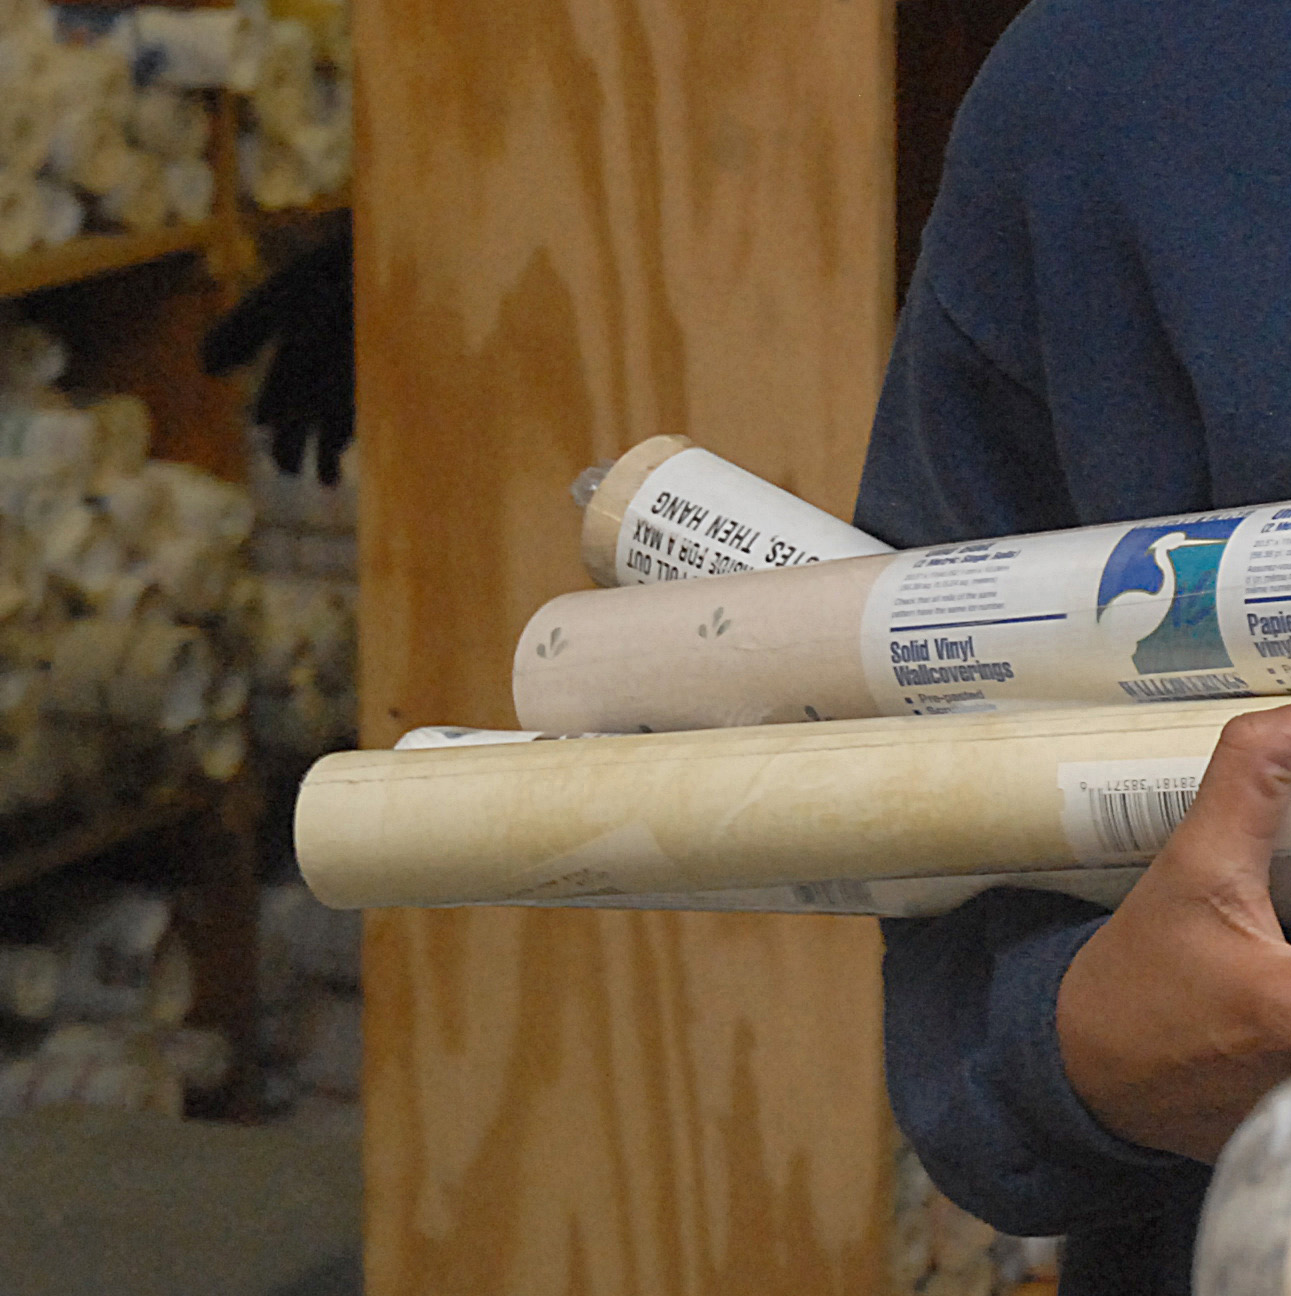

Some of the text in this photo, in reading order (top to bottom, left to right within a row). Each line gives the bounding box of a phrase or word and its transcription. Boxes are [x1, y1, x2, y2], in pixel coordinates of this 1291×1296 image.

[652, 492, 709, 531] HANG
[633, 519, 663, 551] MAX
[667, 534, 675, 555] A
[705, 515, 760, 554] THEN
[626, 549, 652, 575] OUT
[679, 537, 709, 569] FOR
[890, 636, 975, 664] Solid Vinyl
[893, 660, 1015, 687] Wallcoverings
[1107, 778, 1147, 792] 38571
[1156, 776, 1196, 790] 28181
